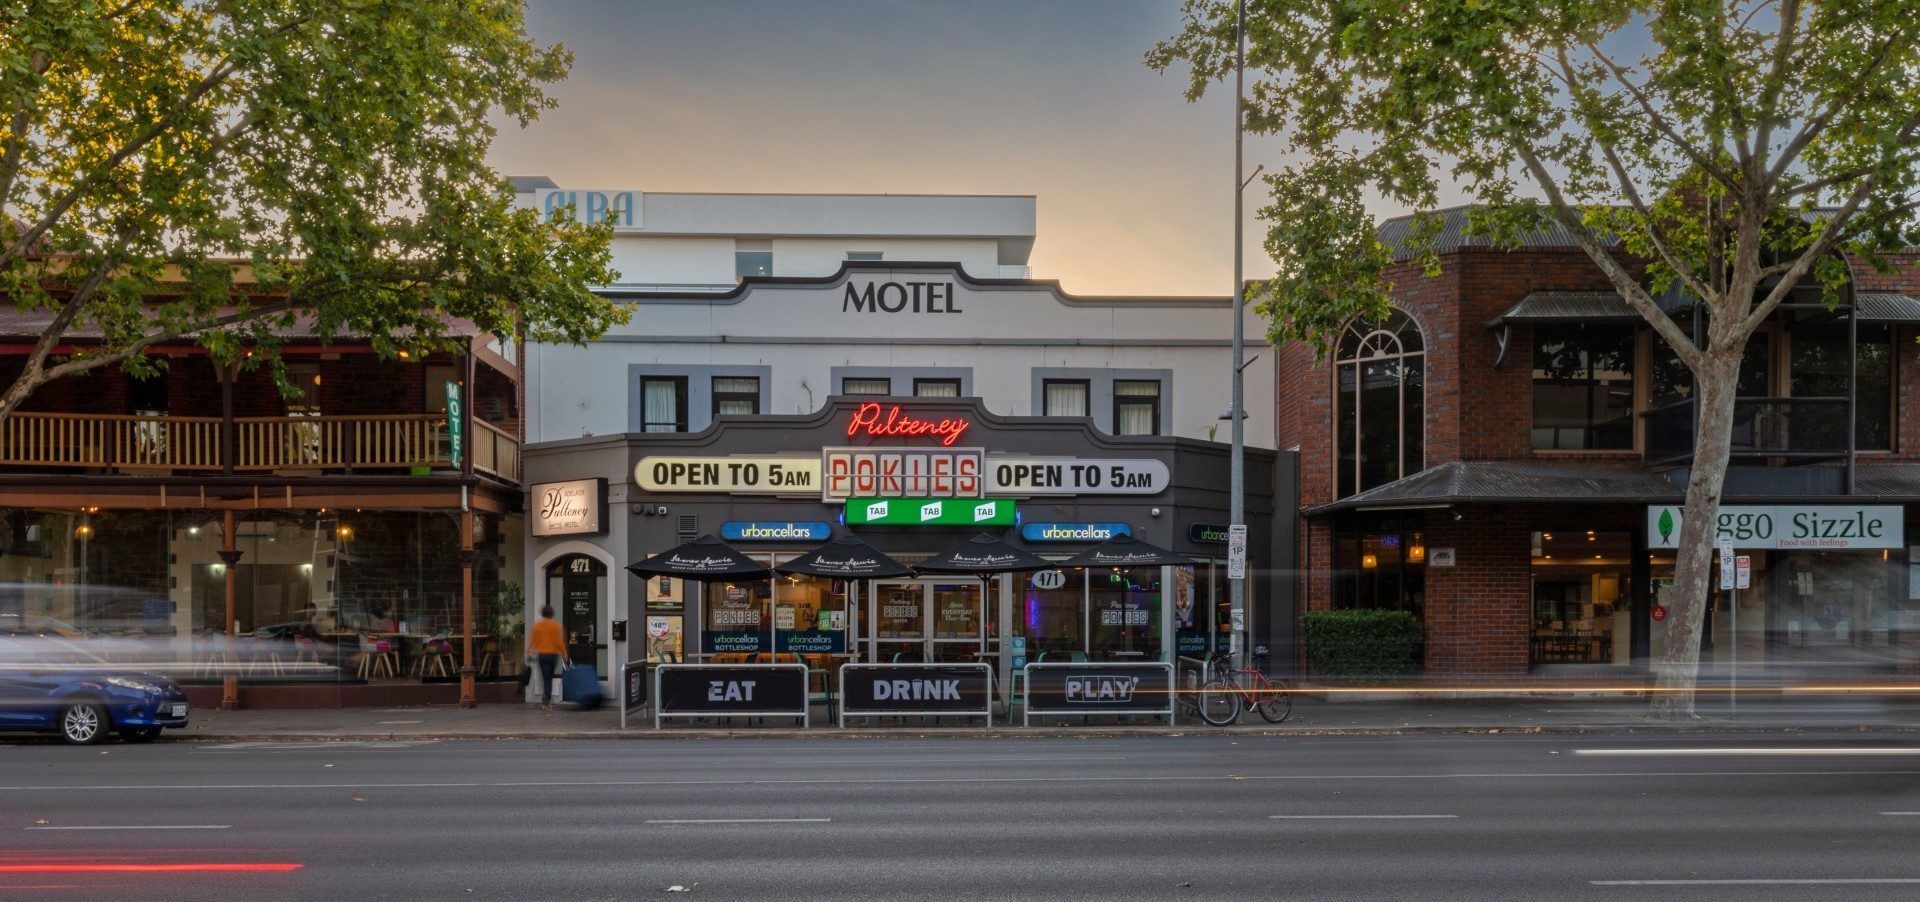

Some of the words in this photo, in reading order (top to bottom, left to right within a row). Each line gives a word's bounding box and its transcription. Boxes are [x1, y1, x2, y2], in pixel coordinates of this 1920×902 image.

[843, 281, 962, 313] MOTEL
[448, 382, 460, 468] MOTEL
[848, 403, 969, 446] Pulteney
[652, 462, 719, 485] OPEN
[728, 462, 759, 485] TO
[768, 464, 811, 485] 5AM
[832, 459, 976, 492] POKIES
[996, 464, 1063, 487] OPEN
[1070, 464, 1101, 487] TO
[1110, 466, 1152, 487] 5AM
[540, 486, 588, 523] Pulteney
[869, 507, 886, 516] TAB
[923, 507, 940, 516] TAB
[977, 507, 994, 517] TAB
[741, 523, 811, 538] urbancellars
[1678, 507, 1773, 540] ggo
[1792, 510, 1883, 539] Sizzle
[1042, 524, 1111, 539] urbancellars
[1201, 525, 1229, 541] urbance
[1233, 546, 1244, 555] 1P
[1780, 539, 1798, 547] Food
[1801, 539, 1818, 547] with
[1820, 539, 1849, 548] feelings
[570, 559, 590, 573] 471
[1723, 557, 1732, 566] 1P
[1039, 572, 1059, 586] 471
[715, 611, 759, 623] POKIES
[714, 633, 759, 644] urbancellars
[787, 633, 832, 644] urbancellars
[708, 680, 756, 701] EAT
[873, 679, 961, 701] DRINK
[1067, 680, 1129, 698] PLAY
